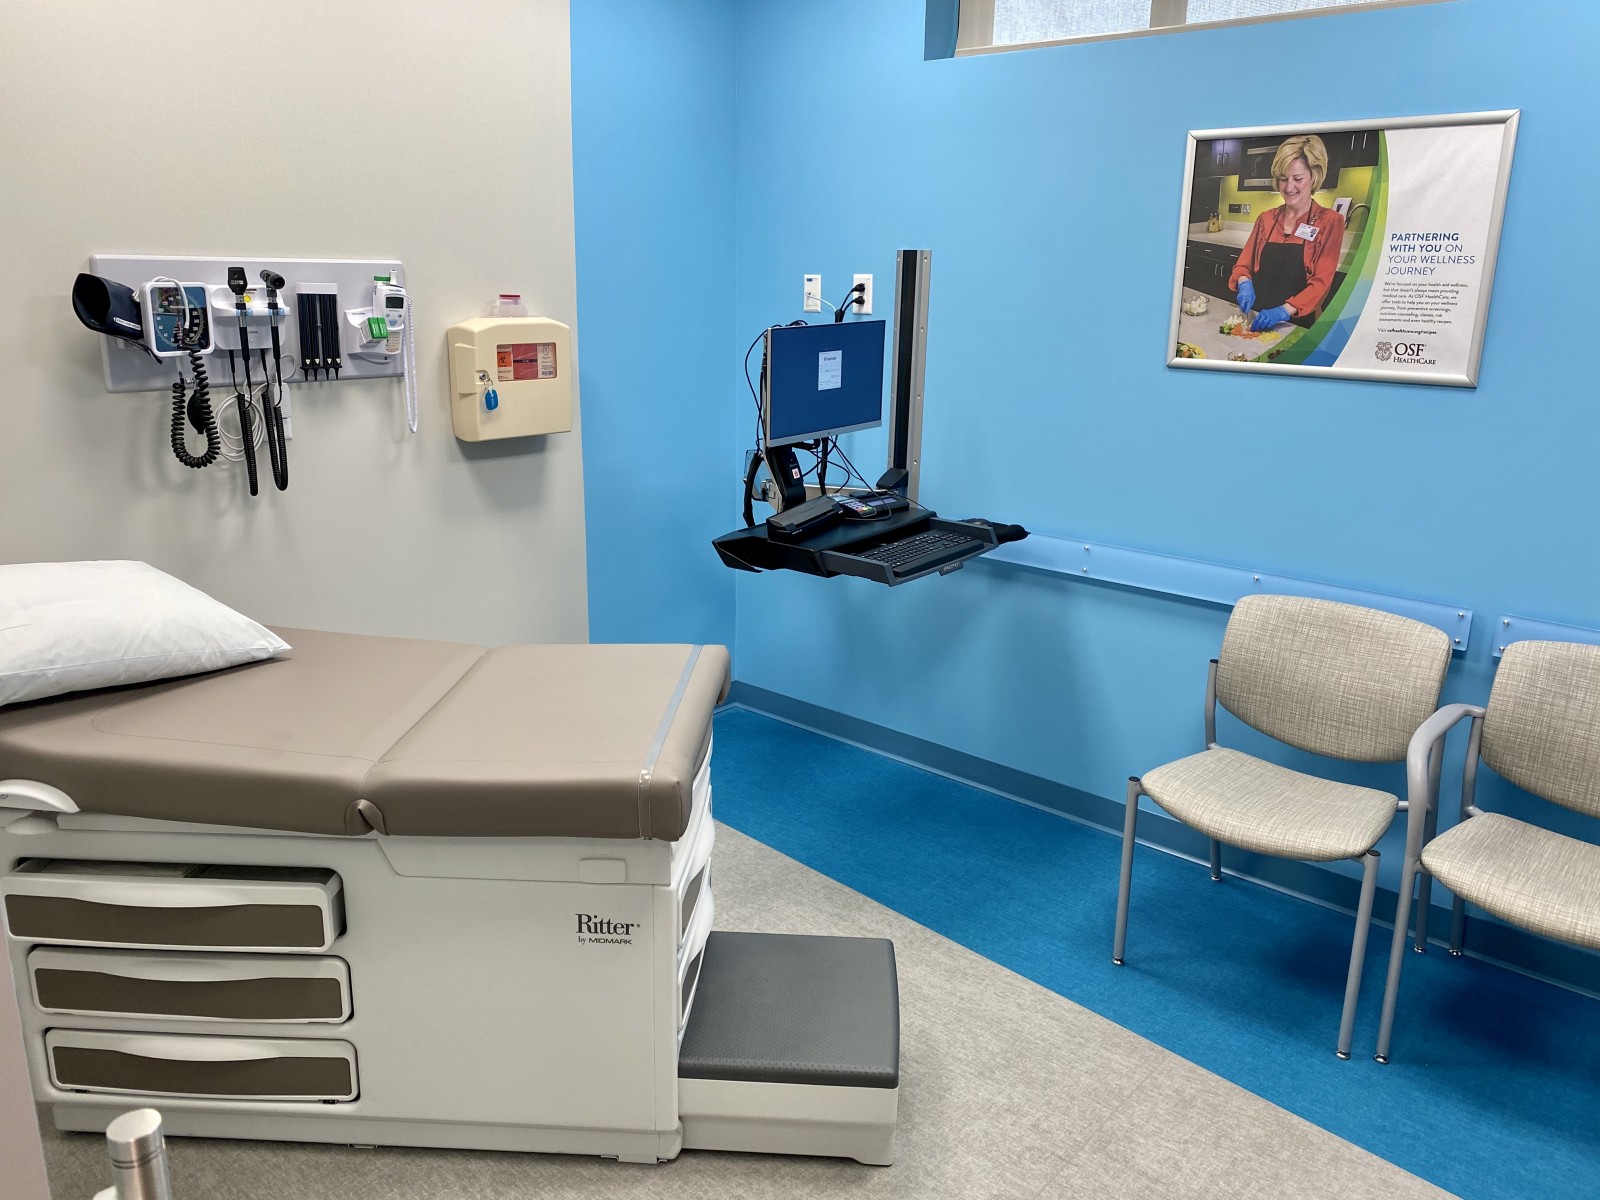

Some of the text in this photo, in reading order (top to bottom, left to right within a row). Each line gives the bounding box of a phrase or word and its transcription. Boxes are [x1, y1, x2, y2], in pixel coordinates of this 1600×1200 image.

[1392, 233, 1459, 241] PARTNERING
[1445, 244, 1462, 252] ON
[1386, 267, 1435, 275] JOURNEY
[1394, 343, 1424, 356] OSF
[575, 914, 634, 935] Ritter
[578, 936, 586, 945] by
